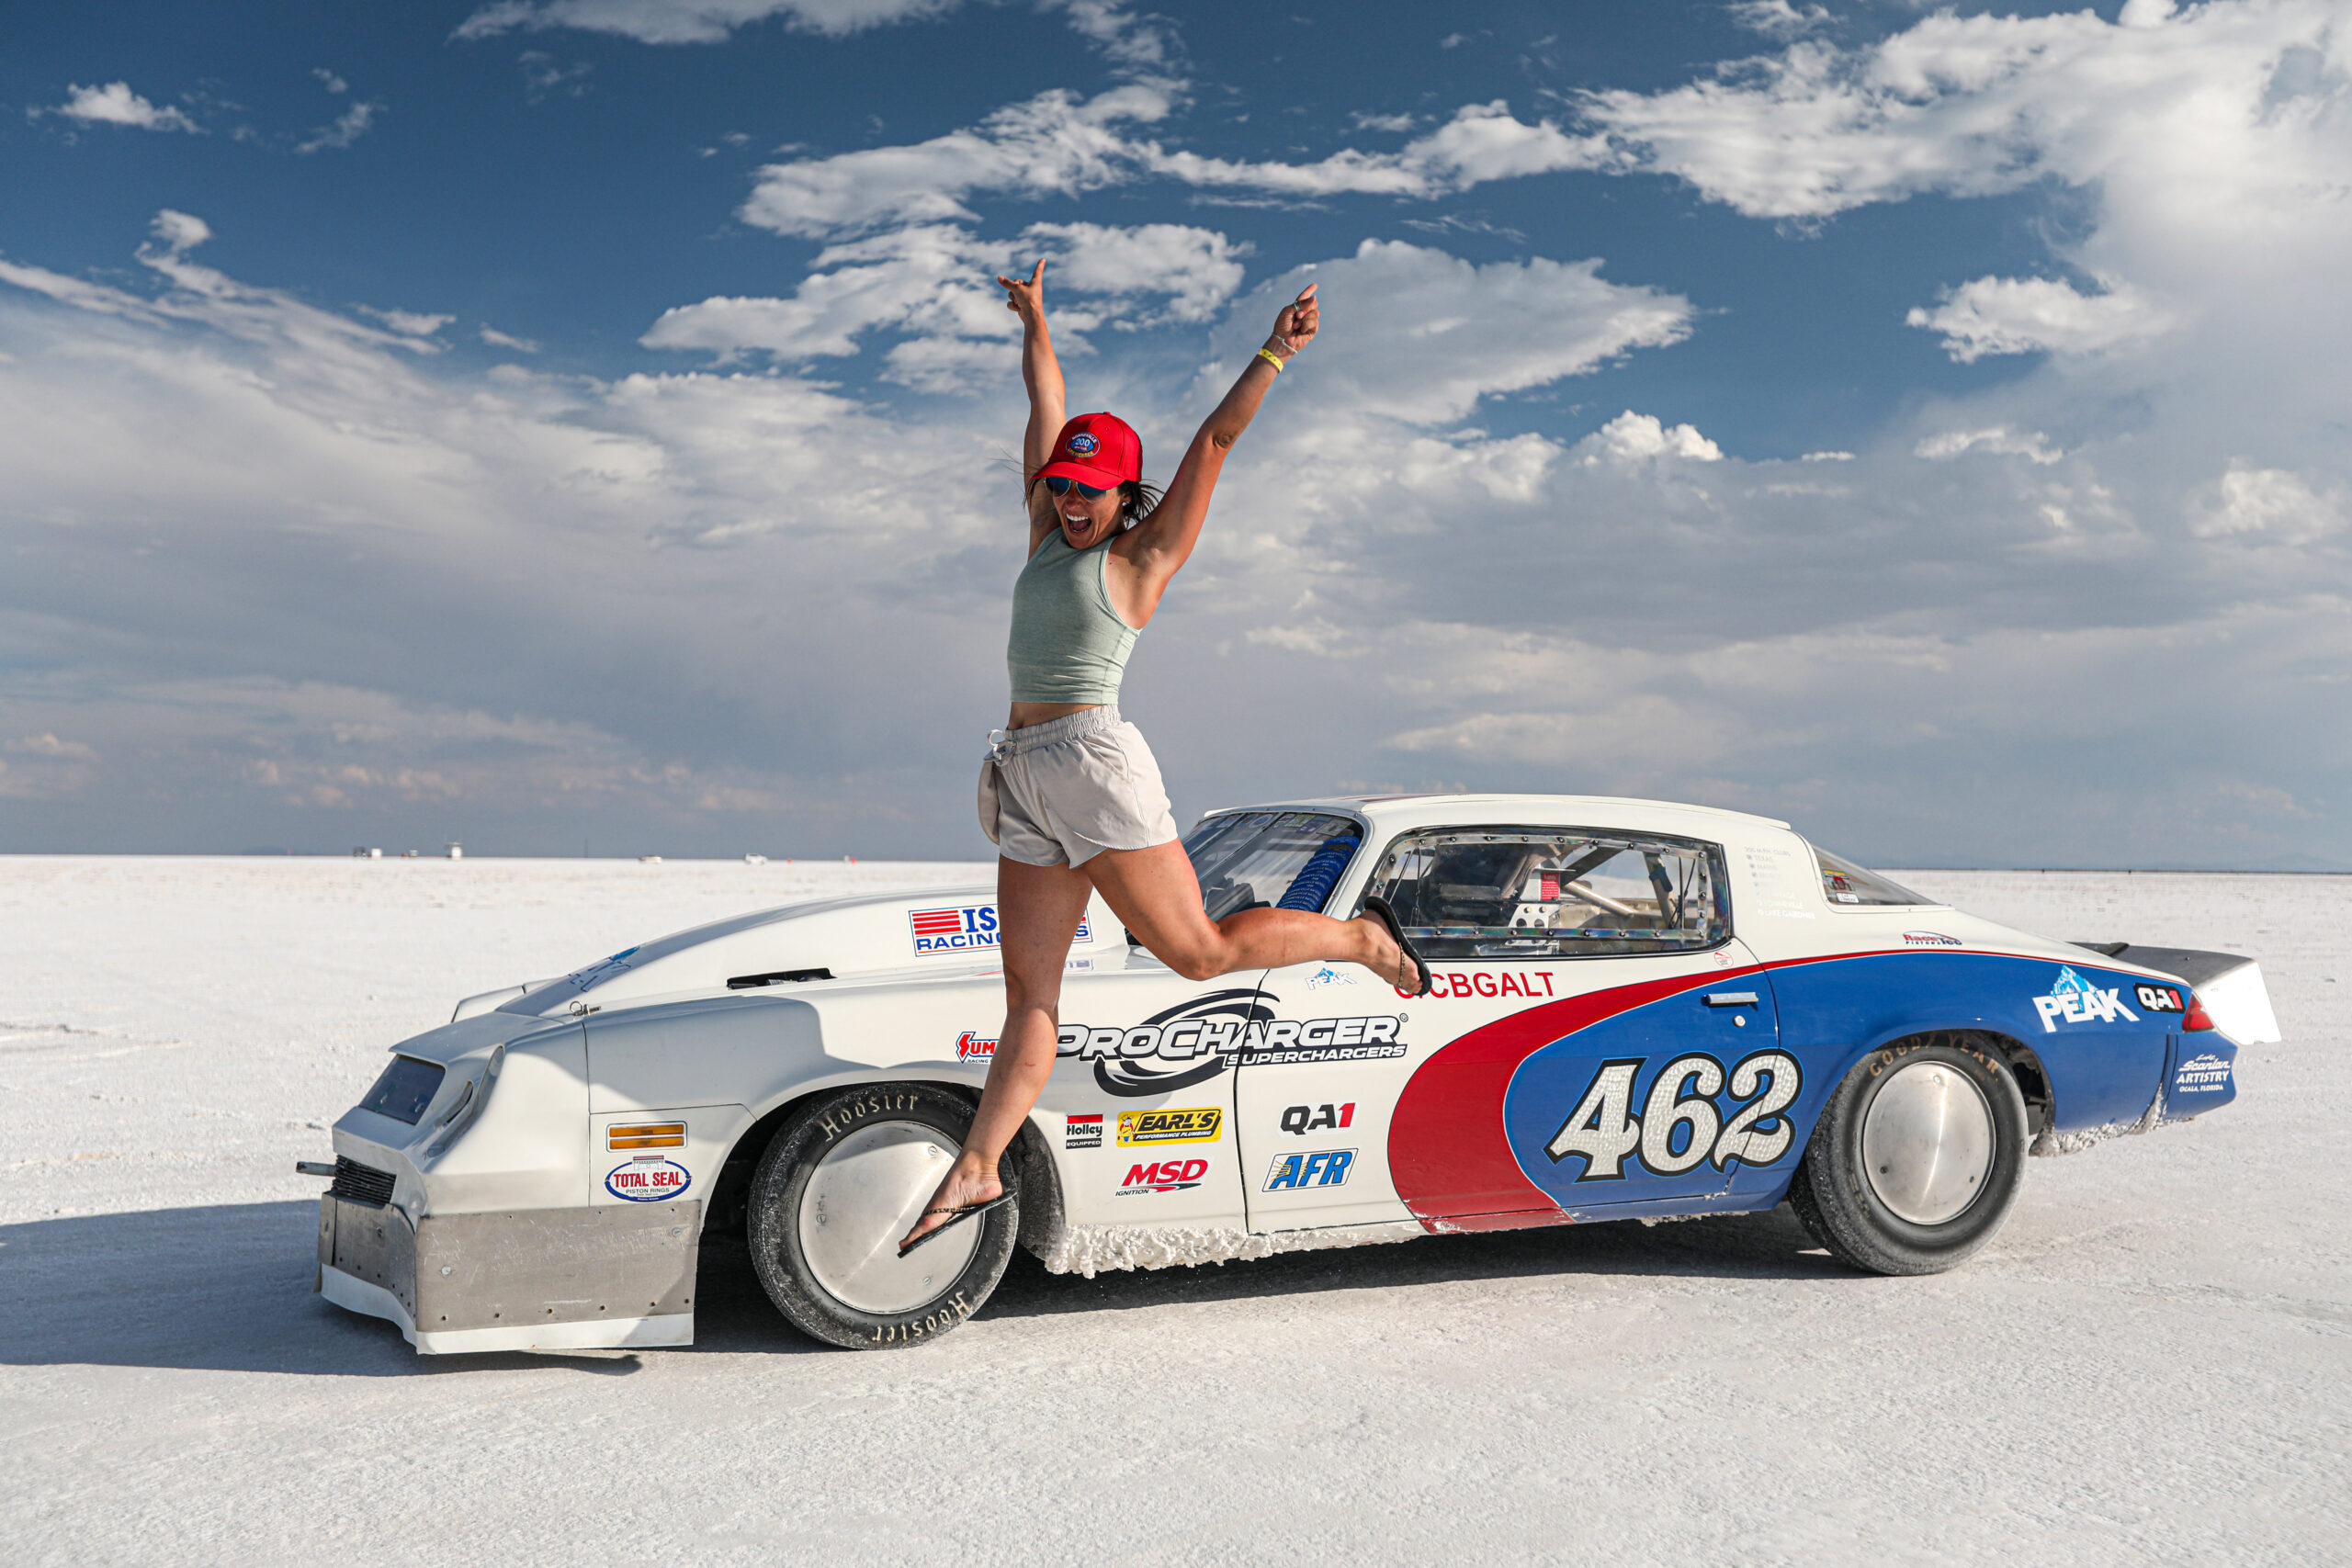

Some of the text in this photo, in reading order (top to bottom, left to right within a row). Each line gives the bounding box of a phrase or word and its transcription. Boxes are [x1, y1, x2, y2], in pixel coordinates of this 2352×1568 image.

[1075, 438, 1091, 446] 200
[963, 907, 998, 933] IS
[916, 931, 1001, 952] RACIN
[1305, 972, 1357, 990] PEAK
[1394, 972, 1555, 999] CBGALT
[2032, 987, 2141, 1033] PEAK
[2137, 987, 2184, 1011] QA1
[958, 1032, 997, 1059] SUM
[1227, 1044, 1408, 1066] SUPERCHARGERS
[2176, 1070, 2230, 1084] ARTISTRY
[2179, 1084, 2223, 1093] OCALA, FLORIDA
[817, 1095, 919, 1142] Hoosier
[1137, 1111, 1216, 1132] EARL'S
[1280, 1102, 1355, 1135] QA1
[1543, 1047, 1804, 1184] 462
[1066, 1123, 1102, 1137] Holley
[1136, 1132, 1180, 1140] PERFORMANCE
[613, 1171, 683, 1188] TOTAL SEAL
[1122, 1159, 1209, 1186] MSD
[1268, 1151, 1352, 1189] AFR
[1115, 1189, 1149, 1197] IGNITION
[872, 1291, 971, 1342] Hoosier
